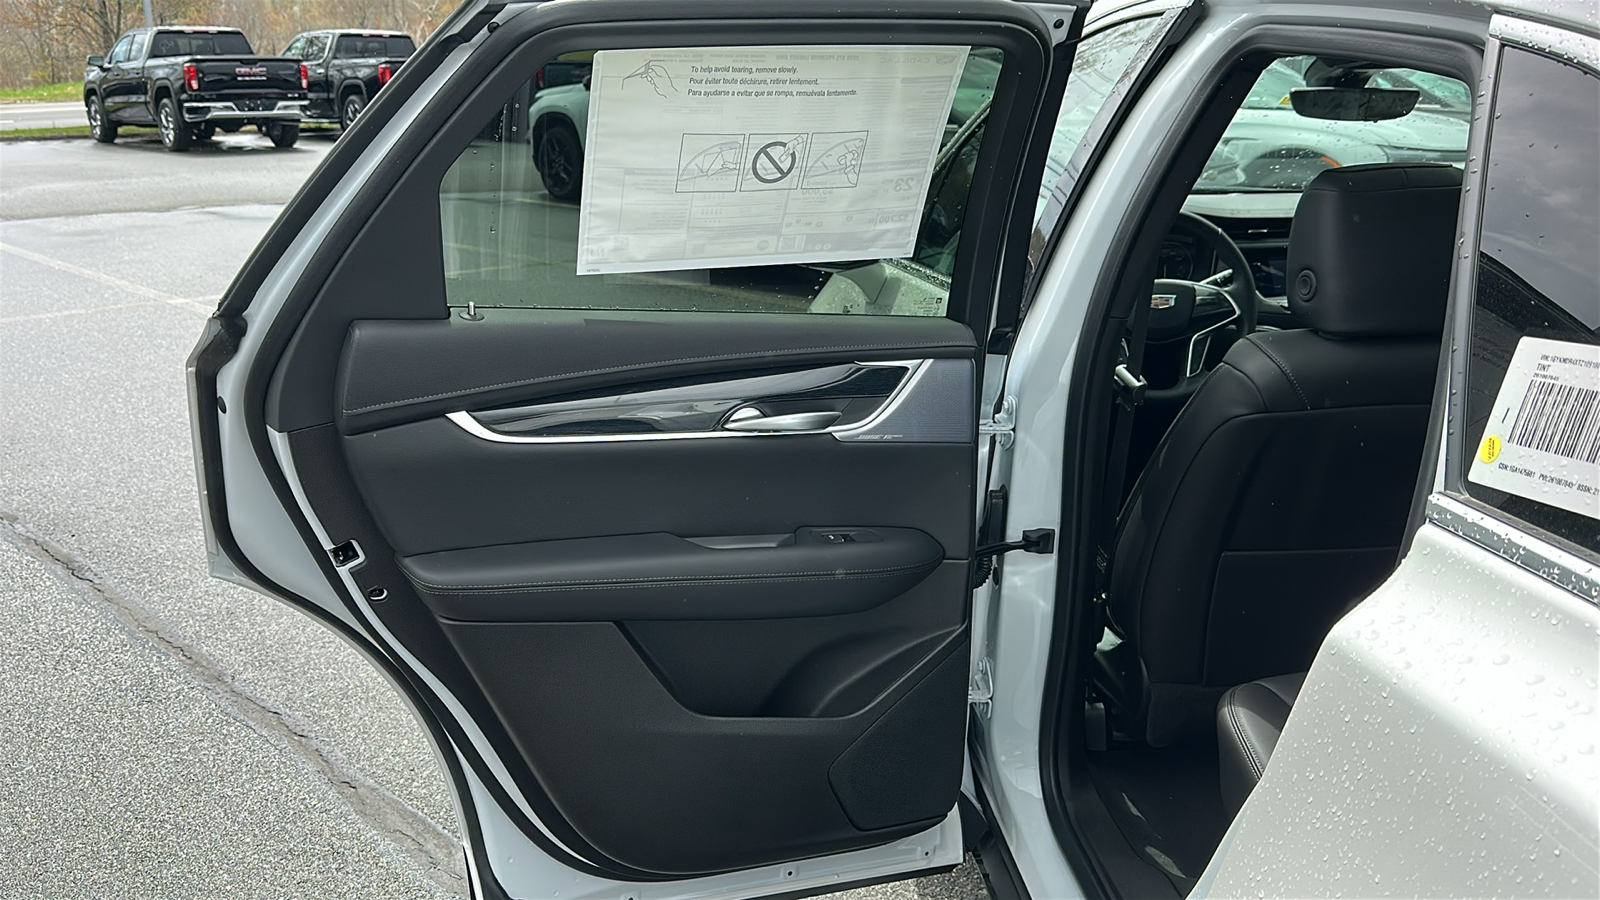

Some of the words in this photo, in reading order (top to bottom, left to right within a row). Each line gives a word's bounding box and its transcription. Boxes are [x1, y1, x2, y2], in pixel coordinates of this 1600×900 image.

[235, 67, 267, 75] GMC
[700, 66, 713, 74] help
[732, 66, 754, 74] tearing,
[778, 66, 798, 74] slowly.
[703, 89, 730, 97] ayudarse
[1536, 363, 1551, 373] TINT
